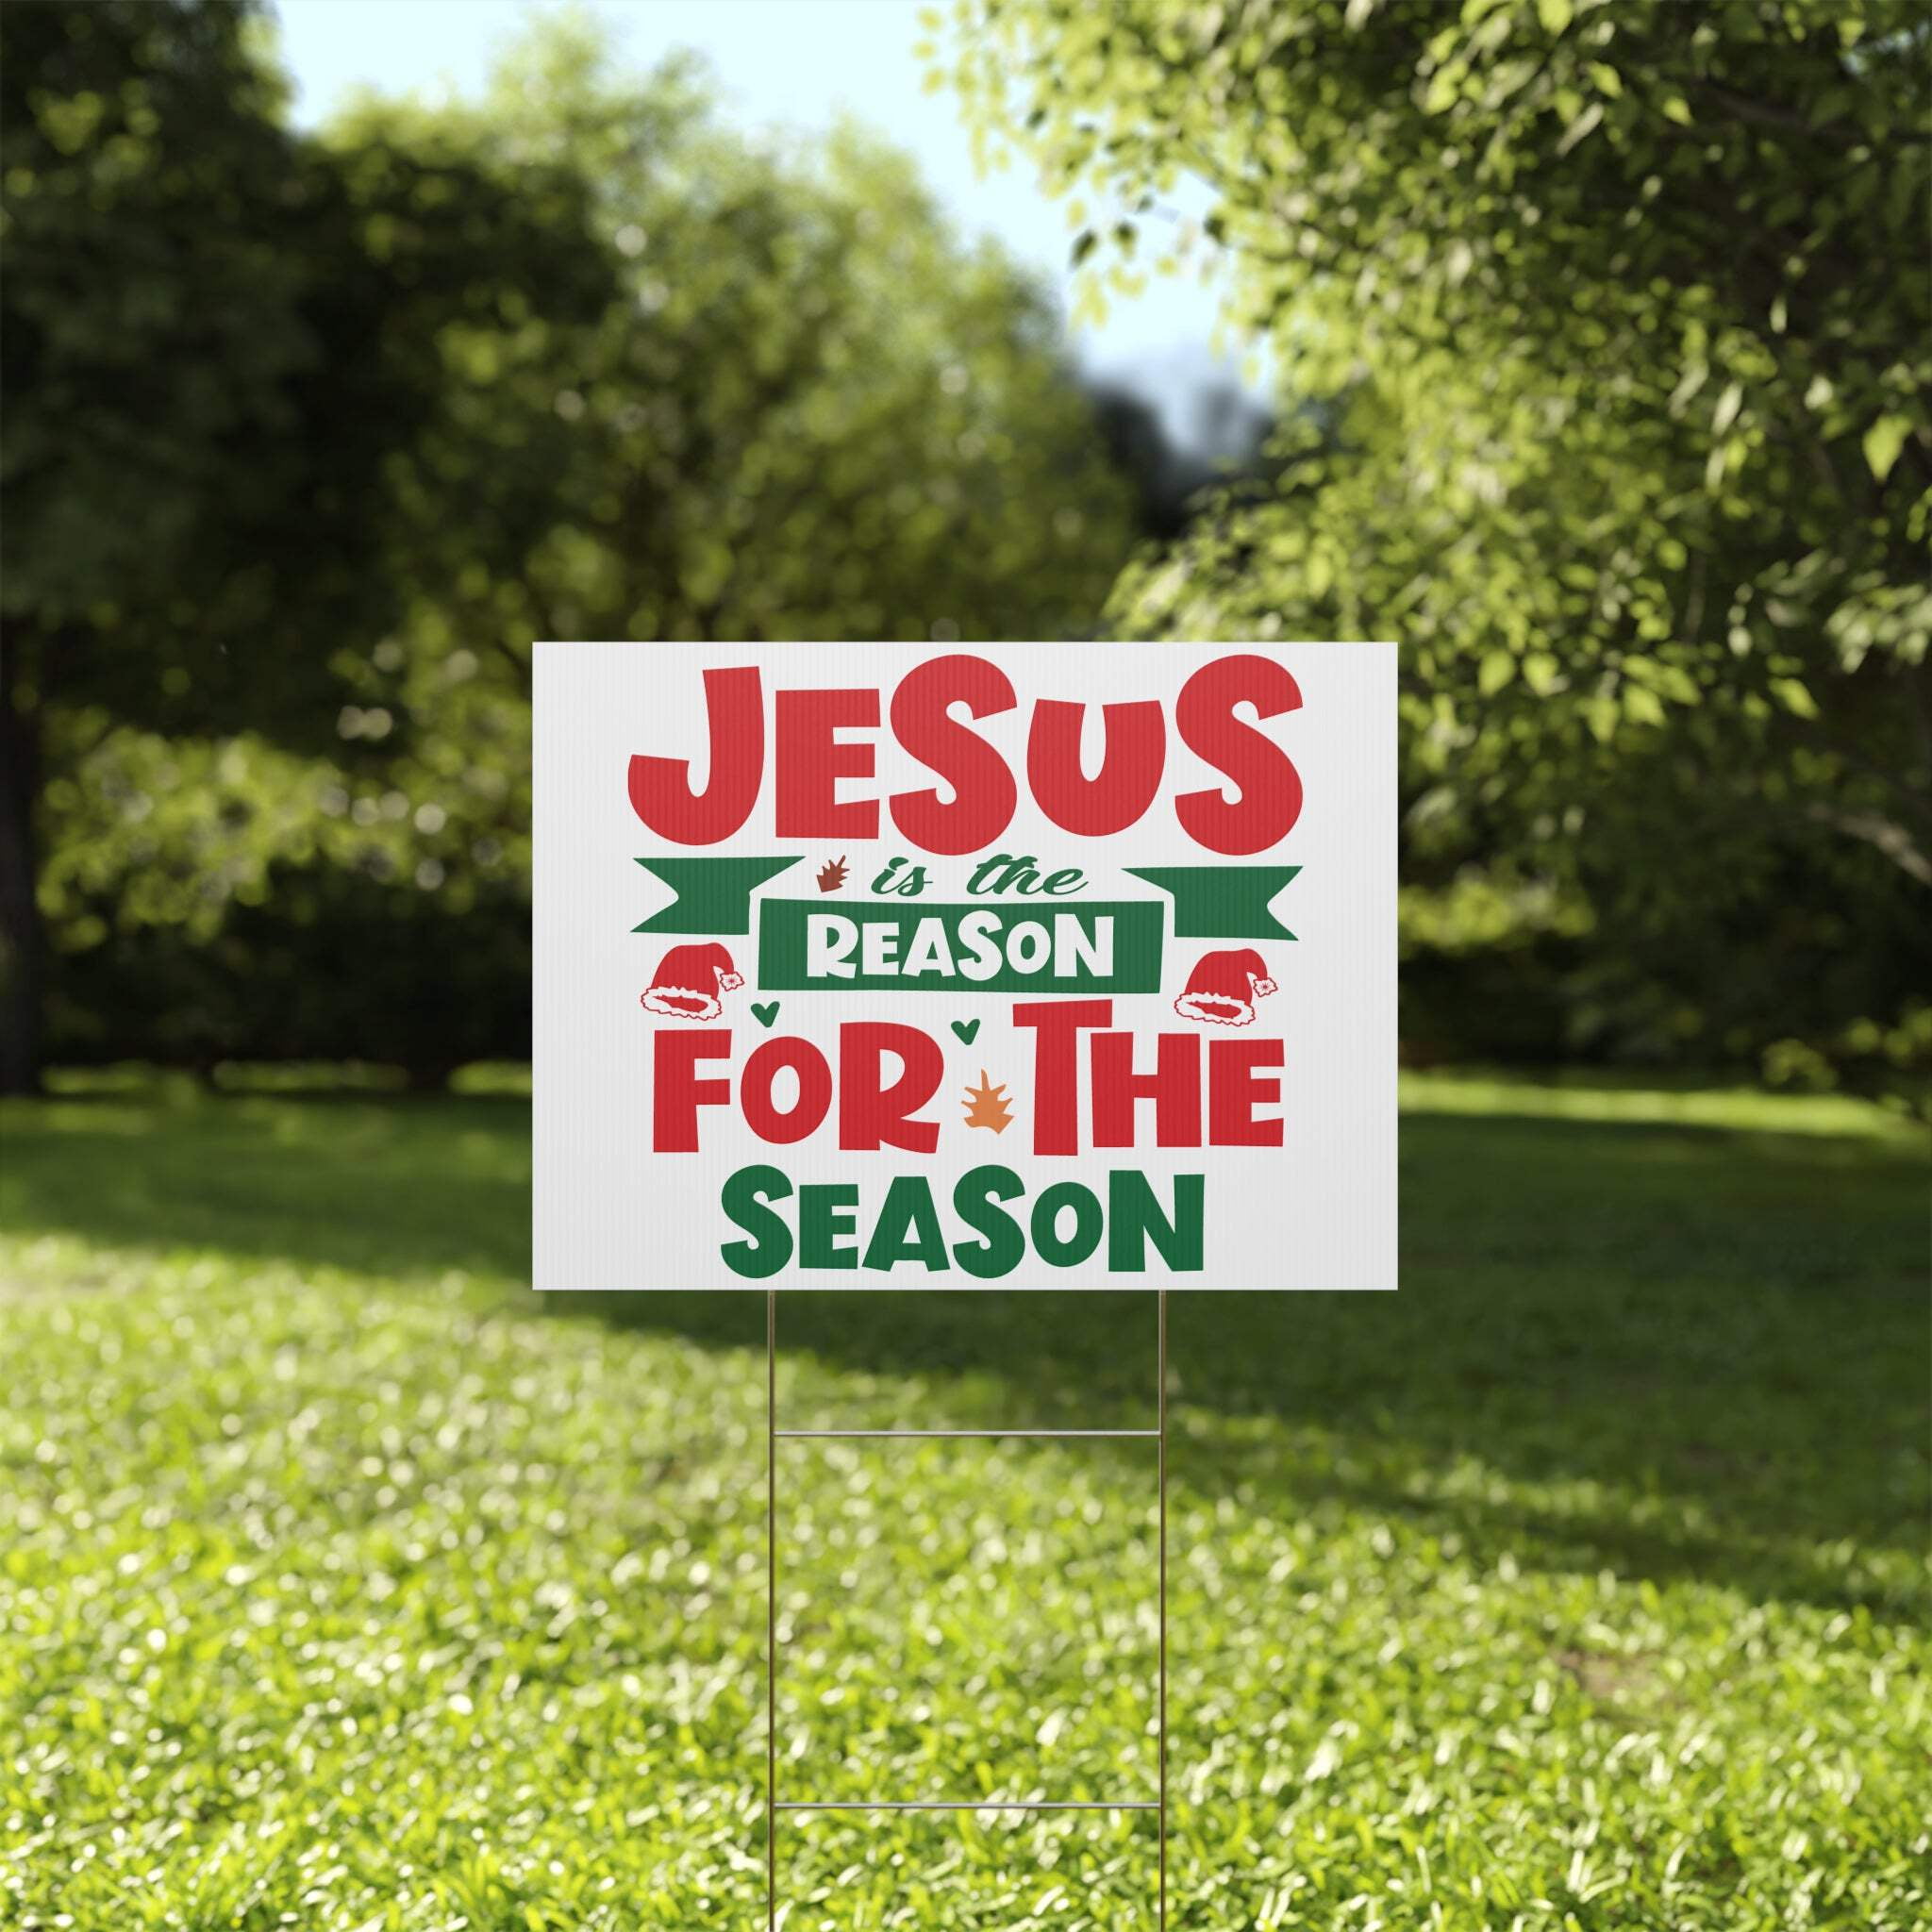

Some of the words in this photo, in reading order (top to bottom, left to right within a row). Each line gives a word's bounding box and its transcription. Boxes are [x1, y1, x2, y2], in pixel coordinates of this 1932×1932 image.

[628, 655, 1303, 856] JESUS
[871, 857, 934, 895] is
[966, 855, 1089, 895] the
[807, 909, 1114, 981] REASON
[654, 1022, 943, 1154] FOR
[1013, 1000, 1284, 1156] THE
[722, 1165, 1205, 1278] SEASON
